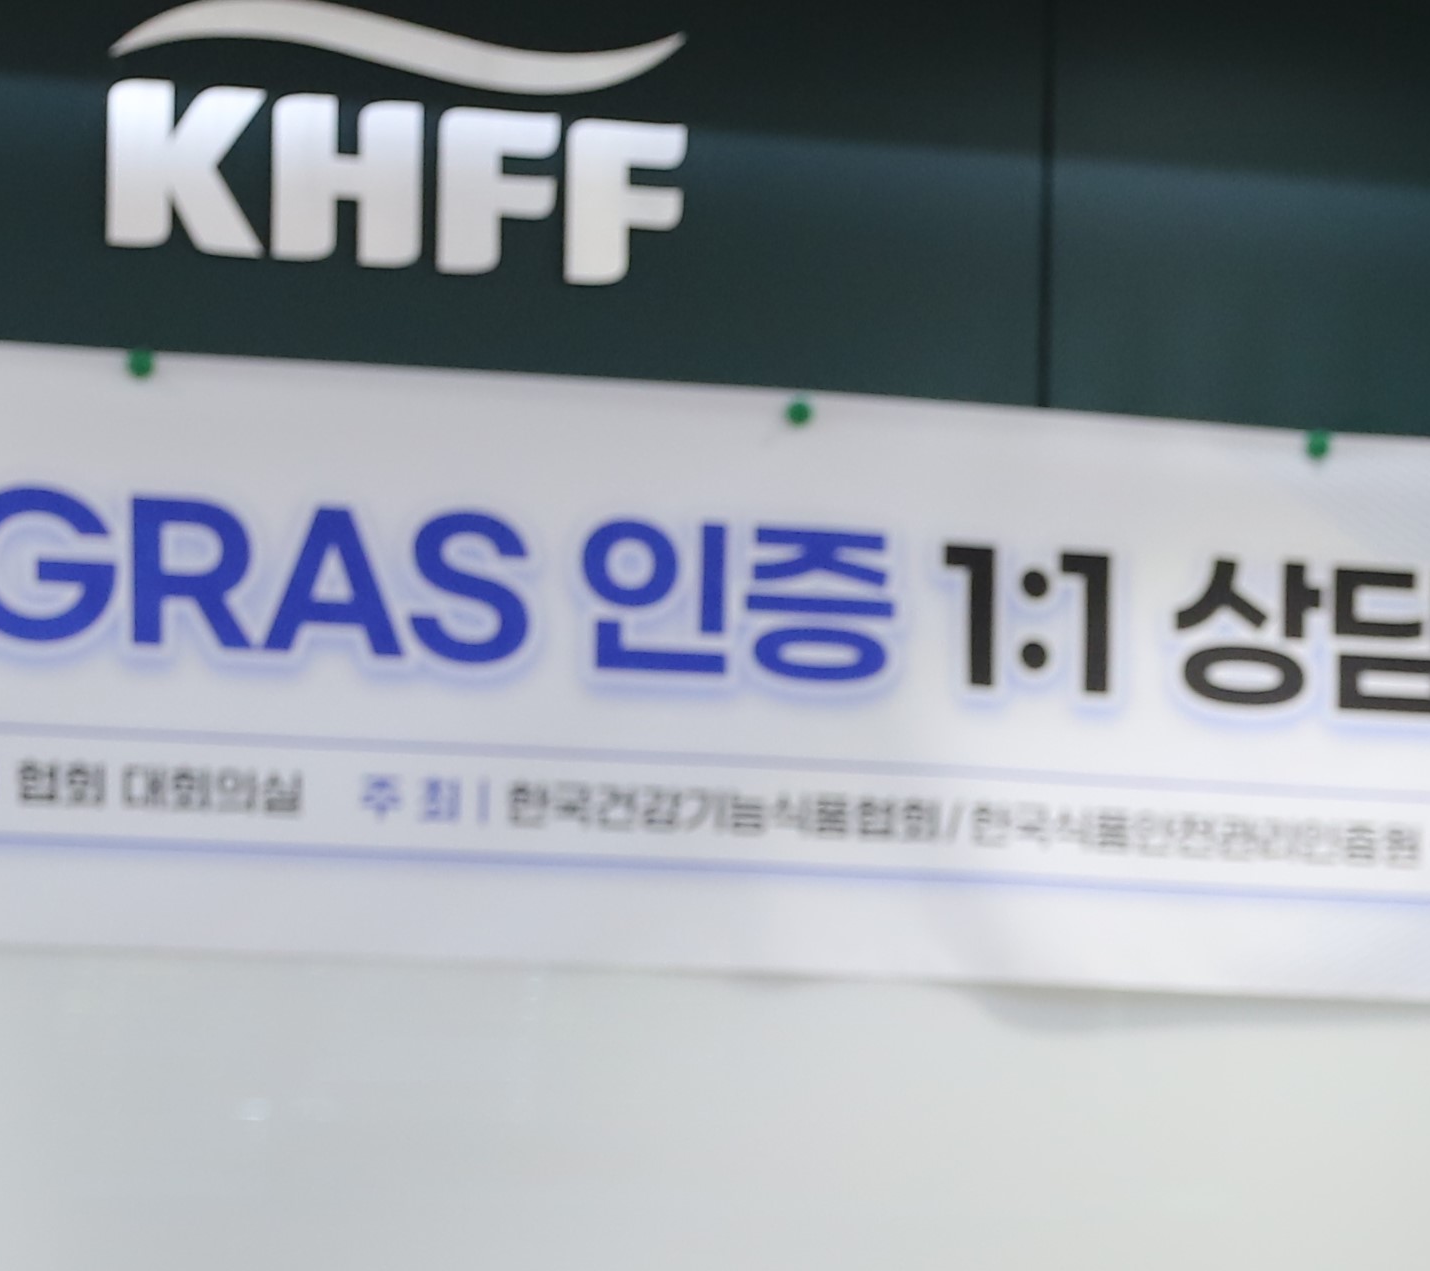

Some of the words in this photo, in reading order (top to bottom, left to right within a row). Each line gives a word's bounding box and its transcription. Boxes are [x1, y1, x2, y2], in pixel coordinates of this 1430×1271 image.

[105, 78, 688, 286] KHFF
[581, 519, 896, 684] 인증
[943, 543, 1113, 695] 1:1
[17, 759, 106, 807] 협회
[121, 764, 303, 816] 대회의실
